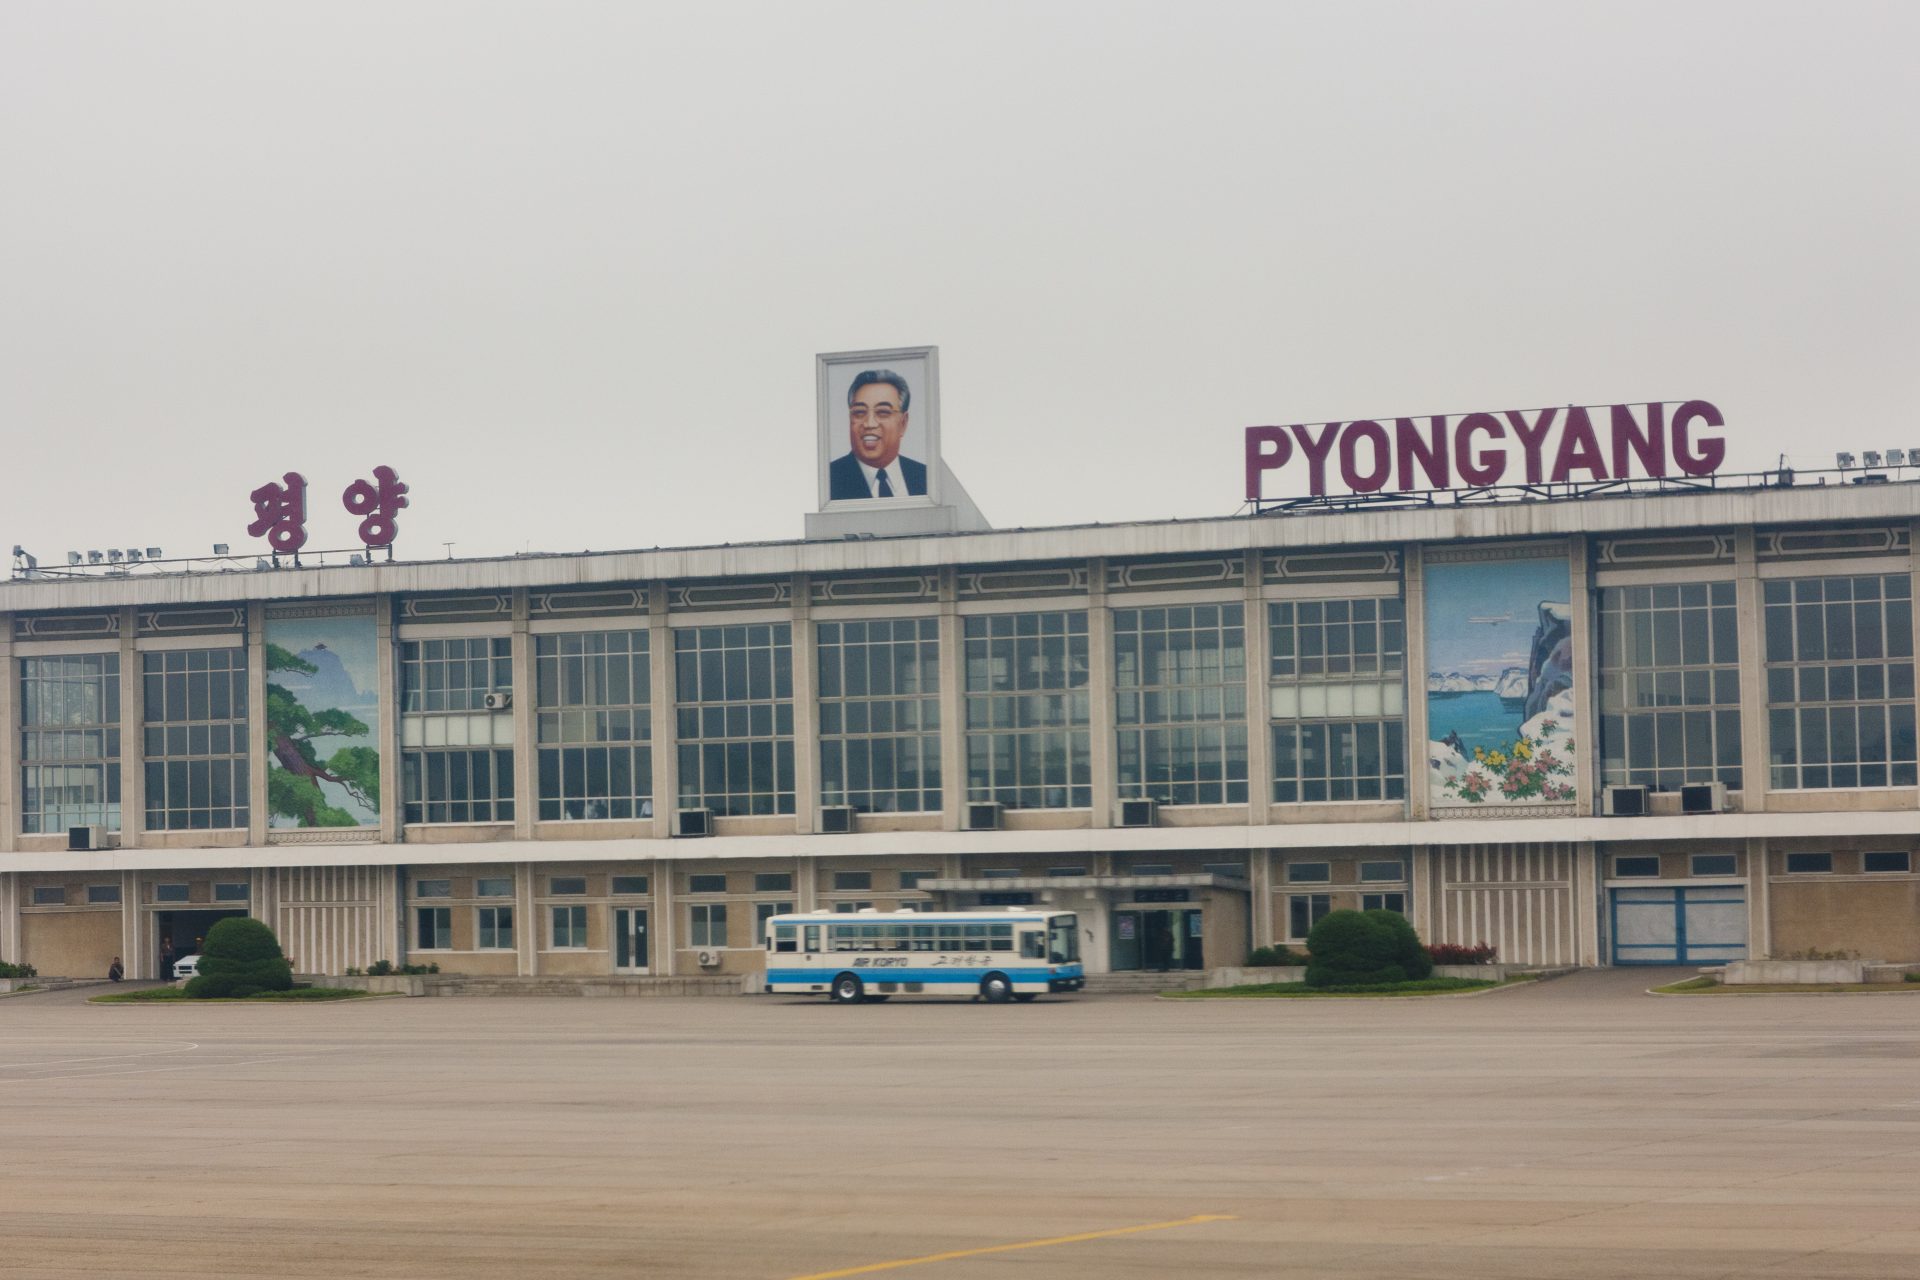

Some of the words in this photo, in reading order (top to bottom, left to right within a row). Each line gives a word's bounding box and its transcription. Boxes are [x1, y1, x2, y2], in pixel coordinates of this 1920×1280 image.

[1245, 399, 1726, 499] PYONGYANG
[247, 465, 409, 554] 평양
[852, 957, 870, 967] AIR
